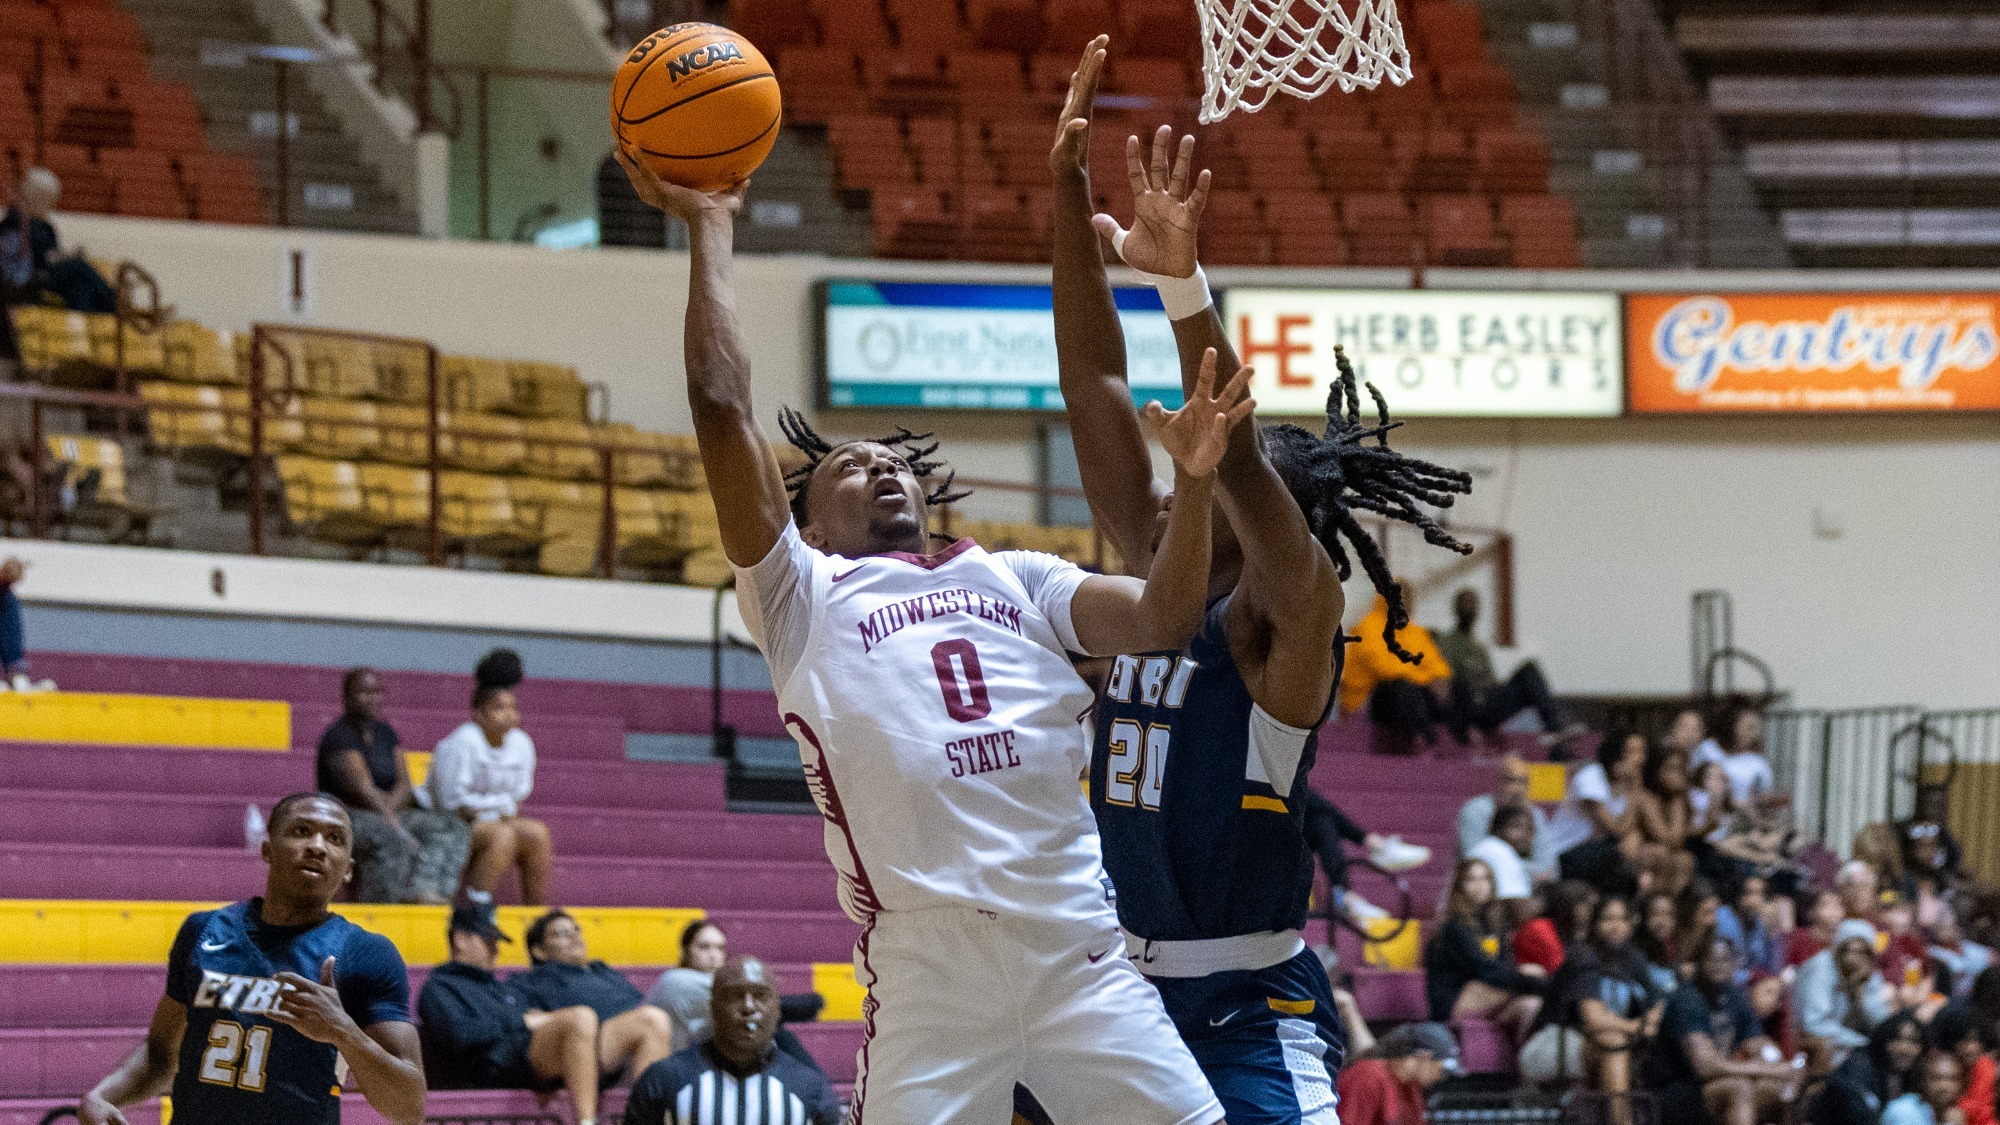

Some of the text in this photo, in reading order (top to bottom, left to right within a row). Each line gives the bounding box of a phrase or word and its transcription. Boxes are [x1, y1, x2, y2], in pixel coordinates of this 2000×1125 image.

[665, 41, 744, 84] NCAA
[1237, 314, 1313, 388] HE
[1334, 313, 1610, 356] HERB EASLEY
[1654, 297, 1997, 391] Gentrys
[857, 588, 1023, 654] MIDWESTERN
[930, 637, 992, 723] 0
[944, 729, 1021, 778] STATE
[1105, 717, 1171, 812] 20
[198, 1019, 273, 1093] 21
